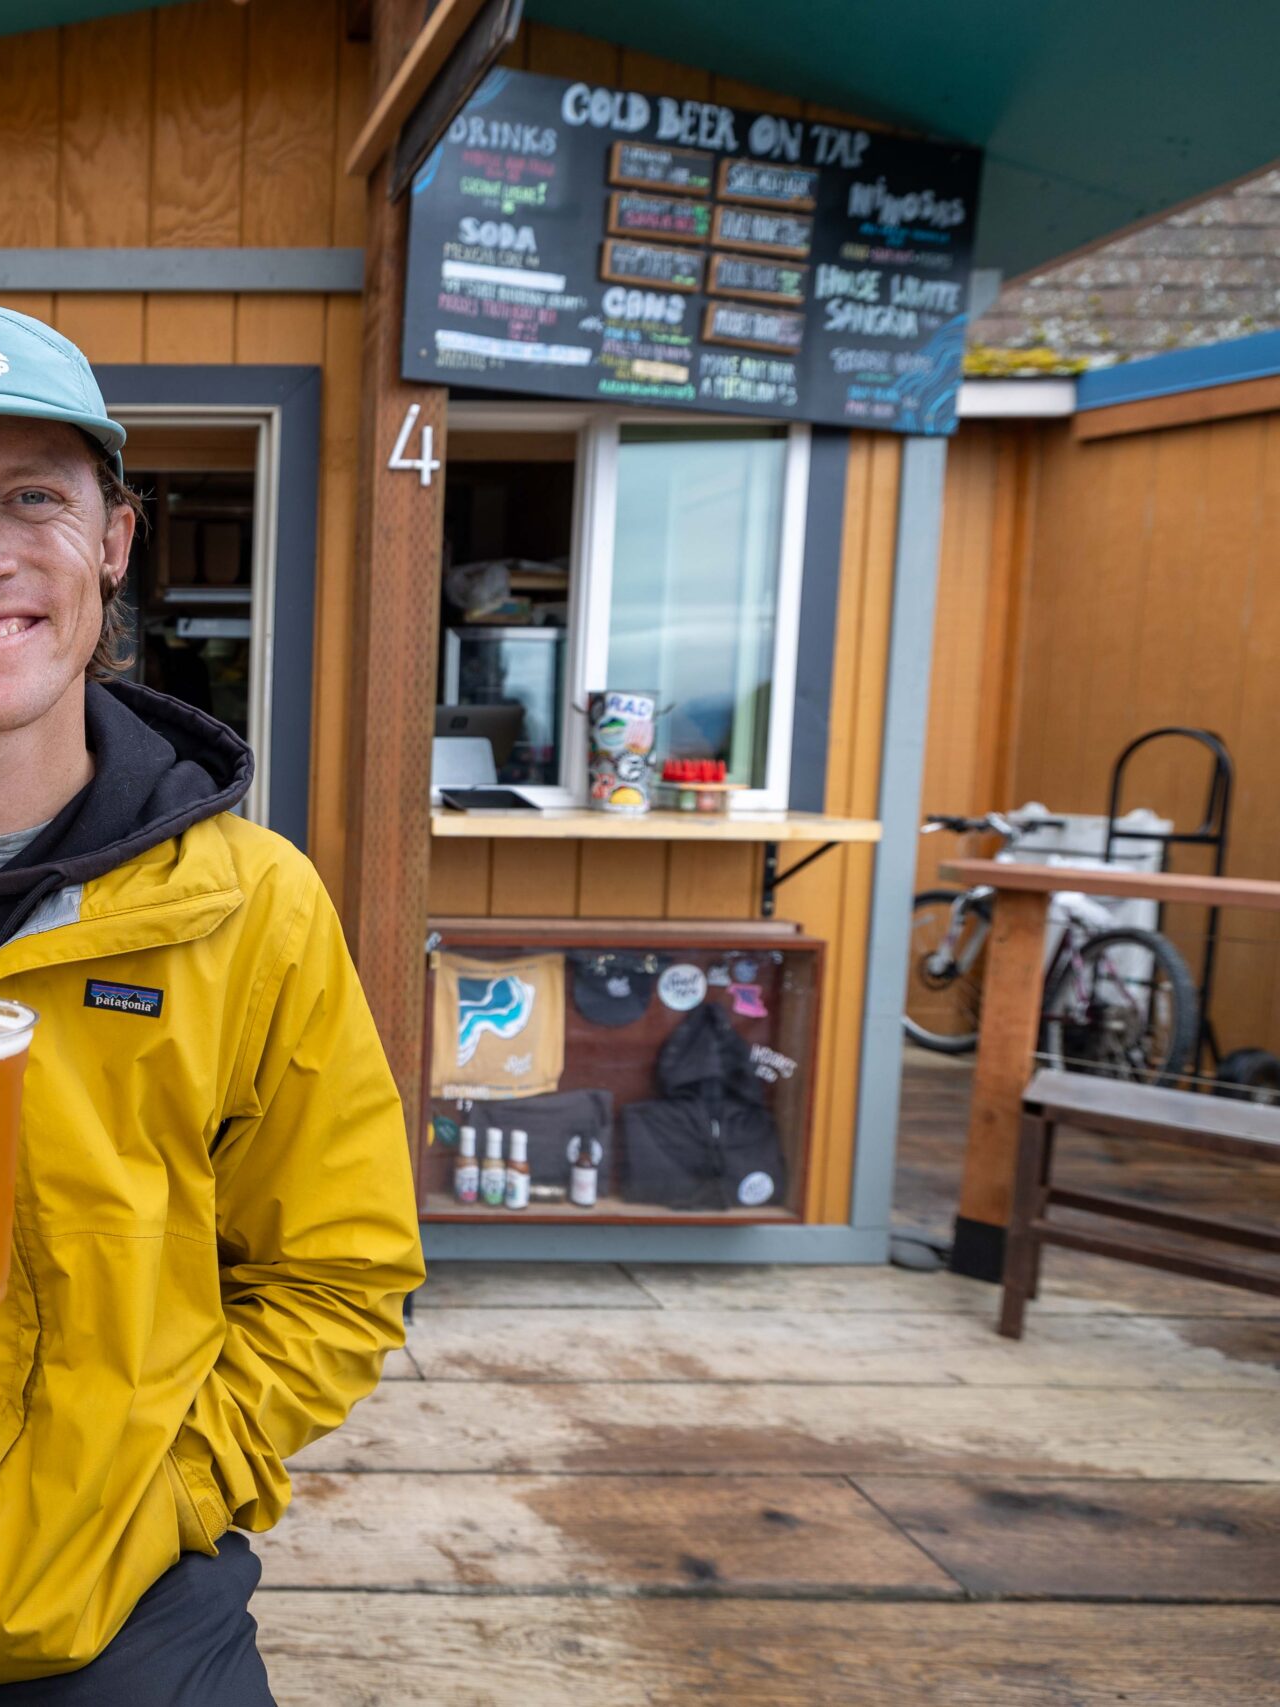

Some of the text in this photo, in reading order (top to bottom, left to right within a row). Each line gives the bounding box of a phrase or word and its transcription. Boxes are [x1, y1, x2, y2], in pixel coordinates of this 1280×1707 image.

[447, 114, 558, 157] DRINKS
[561, 82, 870, 169] COLD BEER ON TAP
[458, 216, 538, 253] SODA
[601, 286, 687, 325] CANS
[387, 403, 440, 486] 4
[95, 995, 152, 1012] patagonia
